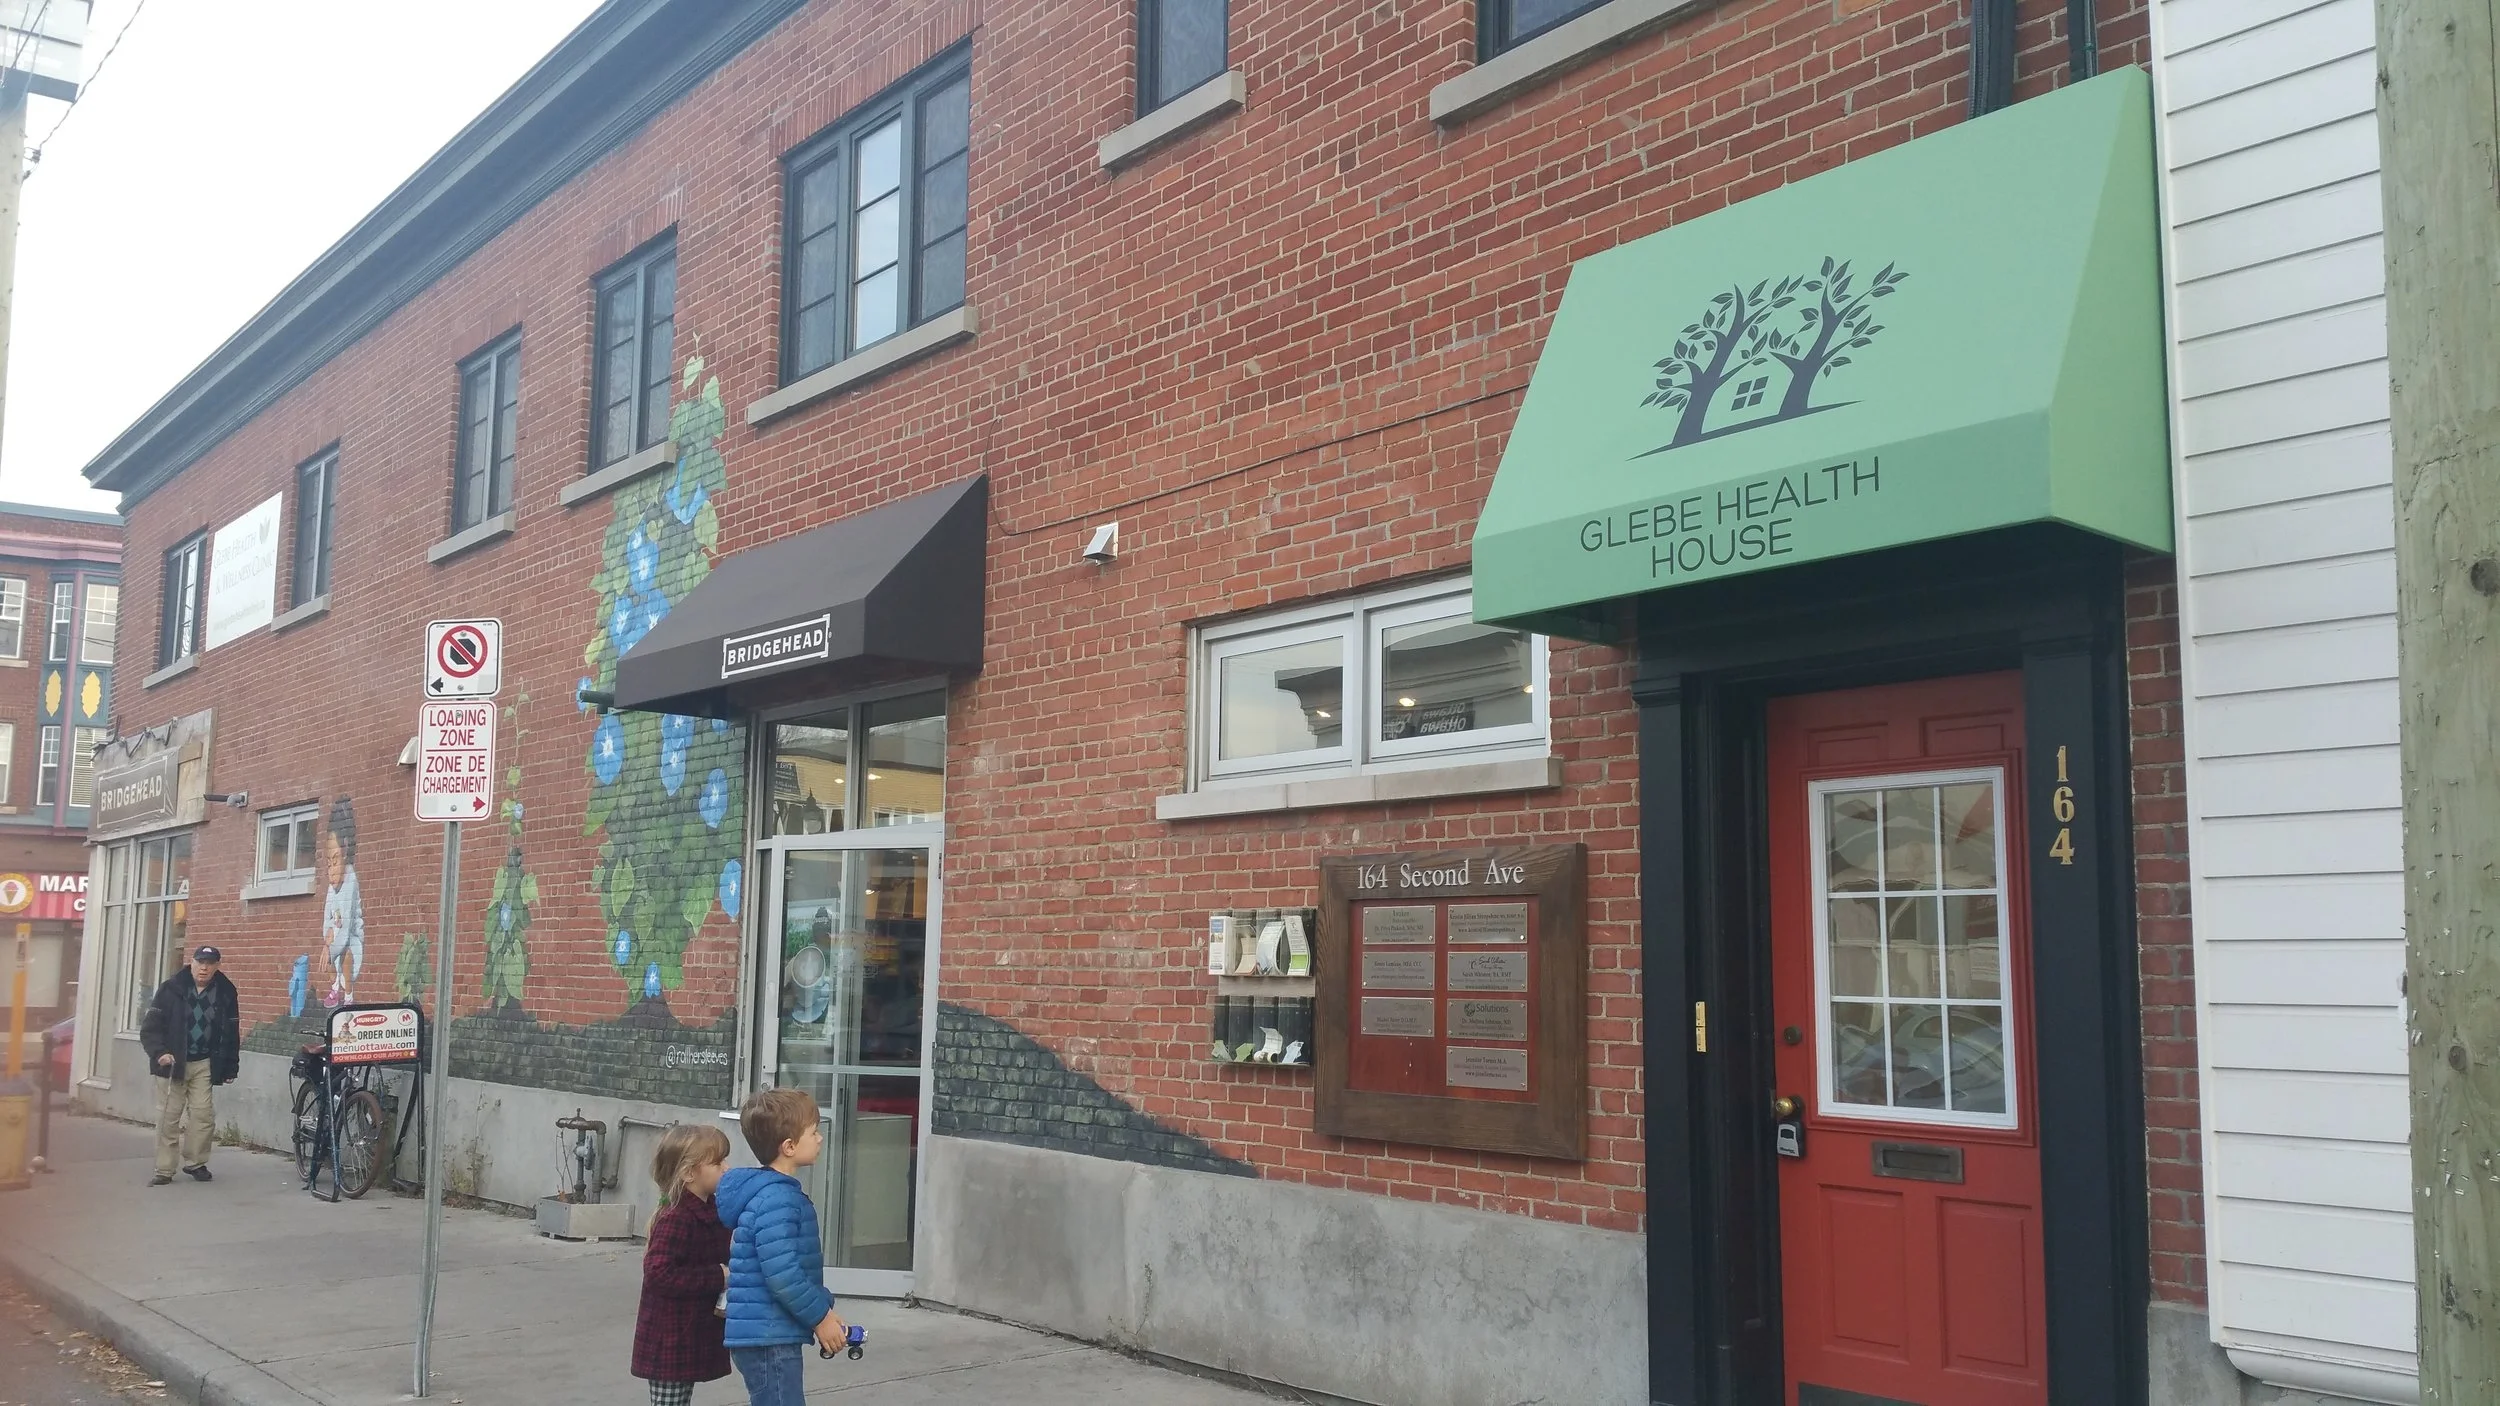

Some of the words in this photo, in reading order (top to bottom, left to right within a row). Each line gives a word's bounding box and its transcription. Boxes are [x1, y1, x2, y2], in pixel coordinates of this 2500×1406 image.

[1580, 495, 1702, 552] GLEBE
[1718, 456, 1879, 525] HEALTH
[1652, 517, 1793, 578] HOUSE
[727, 629, 823, 665] BRIDGEHEAD
[429, 708, 487, 727] LOADING
[439, 729, 475, 746] ZONE
[426, 756, 462, 773] ZONE
[468, 755, 486, 772] DE
[101, 775, 162, 812] BRIDGEHEAD
[422, 776, 487, 794] CHARGEMENT
[2049, 745, 2075, 865] 164
[1357, 864, 1388, 889] 164
[1400, 858, 1471, 888] Second
[1483, 858, 1526, 885] Ave
[1476, 1004, 1508, 1013] Solutions
[356, 1016, 386, 1024] HUNGRY?
[357, 1030, 383, 1040] ORDER
[385, 1028, 416, 1038] ONLINE!
[333, 1041, 415, 1053] menuottawa.com
[334, 1053, 372, 1061] DOWNLOAD
